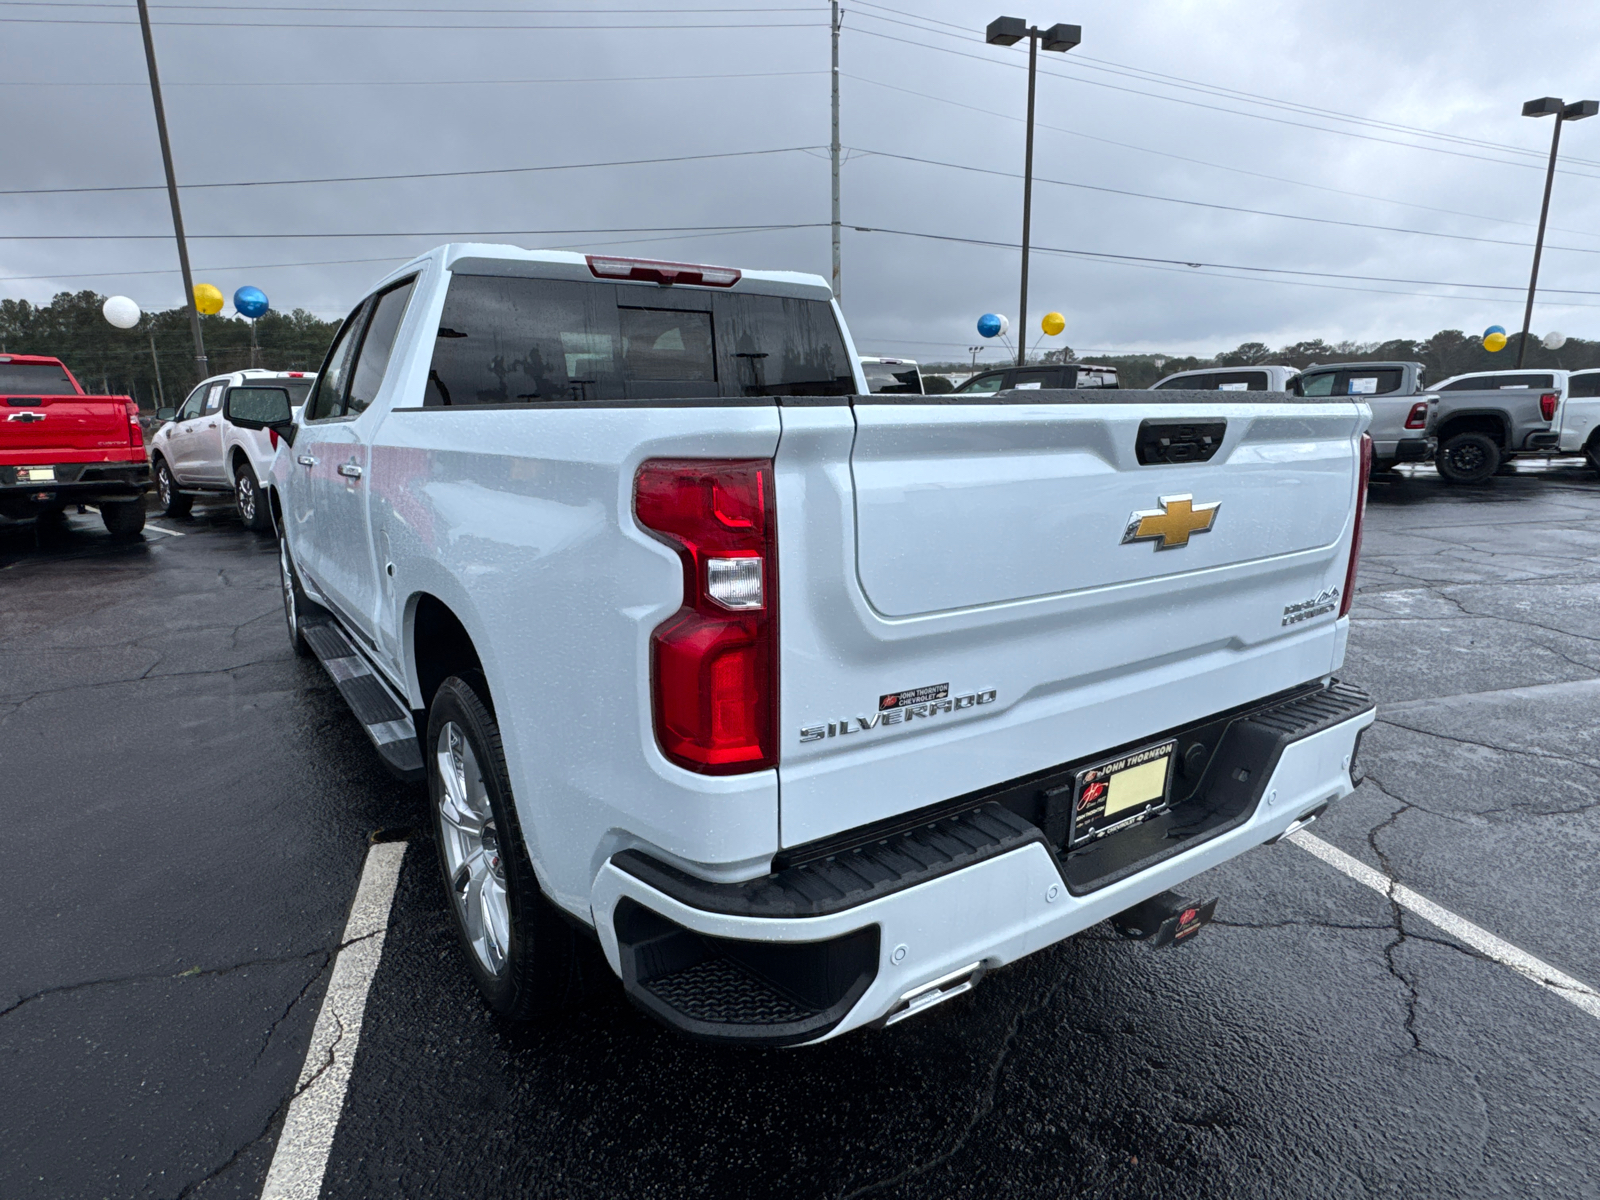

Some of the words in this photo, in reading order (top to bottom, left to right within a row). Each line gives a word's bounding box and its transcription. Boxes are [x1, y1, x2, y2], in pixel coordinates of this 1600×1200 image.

[899, 690, 916, 700] JOHN
[916, 684, 948, 697] THORNTON
[899, 693, 937, 706] CHEVROLET
[800, 686, 997, 743] SILVERADO
[1101, 761, 1126, 776] JOHN
[1126, 744, 1173, 766] THORNTON
